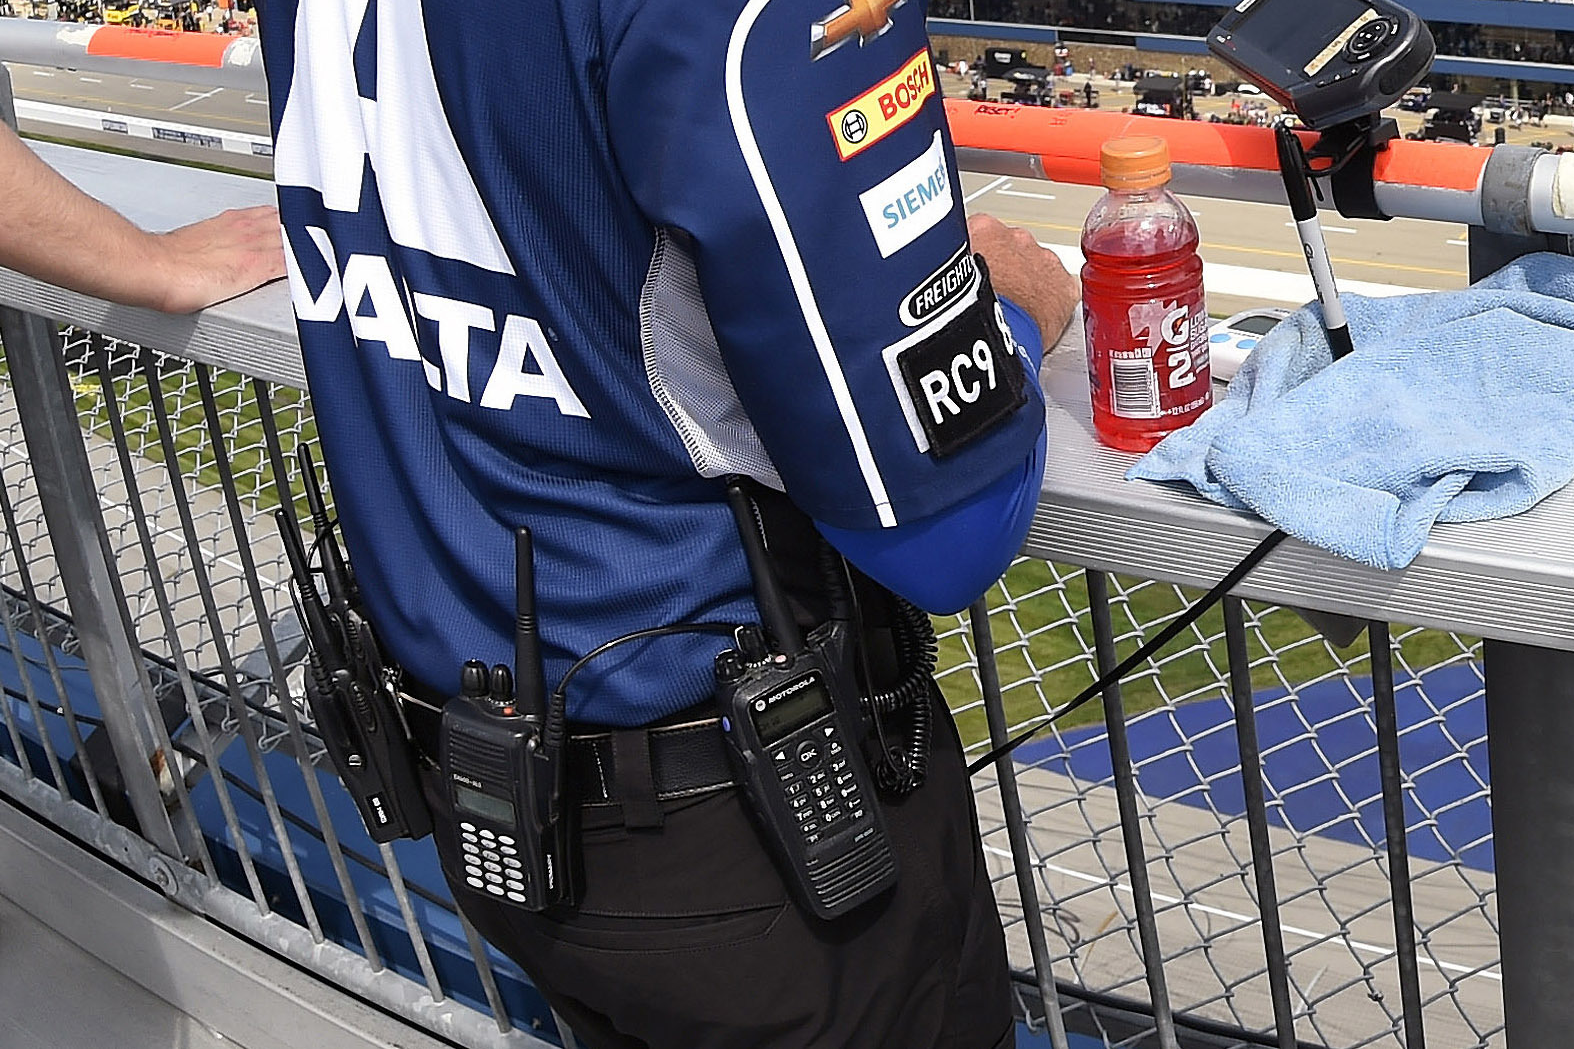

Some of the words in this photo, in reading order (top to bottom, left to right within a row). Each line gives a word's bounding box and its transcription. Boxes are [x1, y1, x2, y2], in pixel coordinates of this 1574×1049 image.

[878, 60, 930, 121] BOSCH
[882, 157, 946, 229] SIEME
[915, 254, 975, 315] FREIGHTL
[768, 676, 816, 704] MOTOROLA
[800, 748, 817, 762] OK
